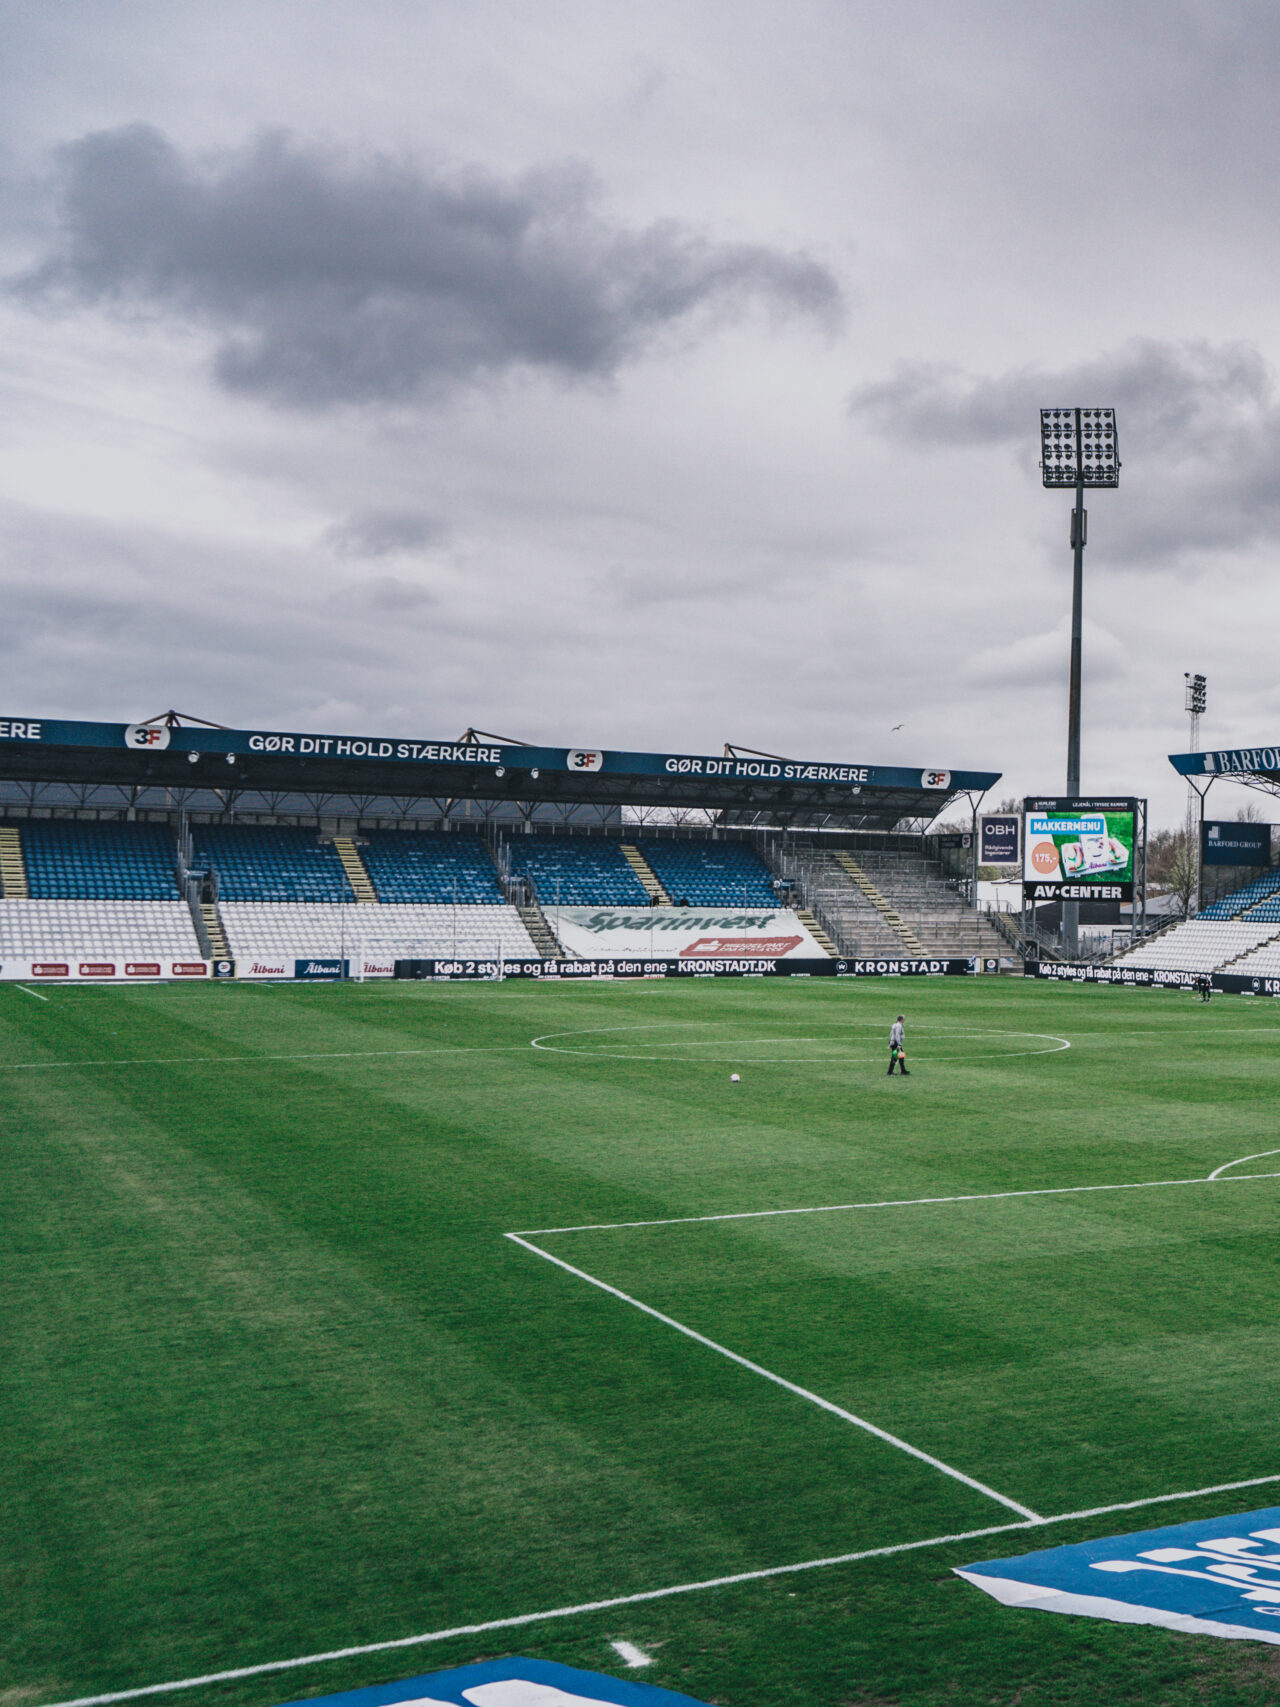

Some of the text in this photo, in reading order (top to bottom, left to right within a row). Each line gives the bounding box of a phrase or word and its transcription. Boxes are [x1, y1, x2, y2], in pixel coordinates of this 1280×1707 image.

[134, 729, 161, 745] 3F
[249, 735, 501, 763] GØR DIT HOLD STÆRKERE
[574, 753, 596, 767] 3F
[665, 758, 868, 782] GØR DIT HOLD STÆRKERE
[927, 772, 945, 786] 3F
[985, 824, 1015, 835] OBH
[1034, 821, 1101, 832] MAKKERMENU
[1208, 840, 1238, 848] BARFOED
[1035, 853, 1057, 863] 175,-
[582, 911, 776, 933] Sparinvest
[435, 961, 463, 974] Køb
[465, 961, 475, 974] 2
[523, 963, 541, 976] og
[543, 960, 558, 974] få
[560, 961, 596, 974] rabat
[599, 960, 615, 975] på
[617, 961, 641, 973] den
[644, 961, 668, 972] ene
[678, 960, 776, 972] KRONSTADT.DK
[855, 961, 949, 973] KRONSTADT
[1039, 963, 1051, 975] Køb
[1052, 964, 1057, 975] 2
[1057, 965, 1077, 980] styles
[1077, 968, 1086, 981] og
[1086, 965, 1094, 977] få
[1094, 965, 1112, 978] rabat
[1112, 967, 1121, 981] på
[1122, 969, 1135, 980] den
[1136, 971, 1149, 981] ene
